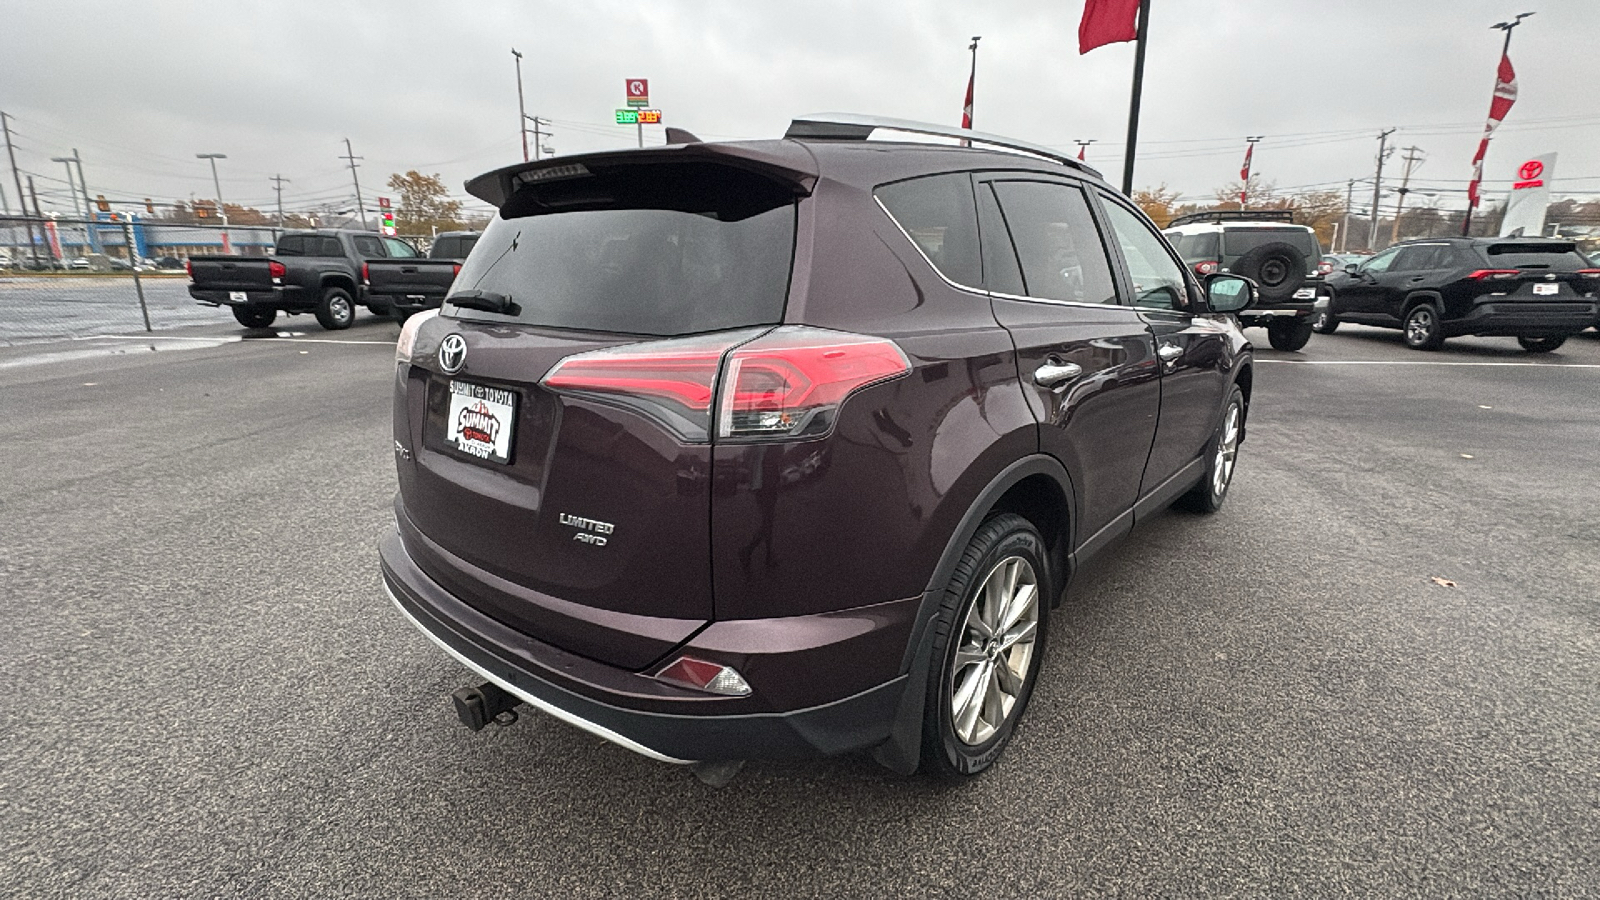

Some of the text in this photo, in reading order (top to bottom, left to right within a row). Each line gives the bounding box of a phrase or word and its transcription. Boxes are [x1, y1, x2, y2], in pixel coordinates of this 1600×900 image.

[450, 380, 513, 407] SUMMIT TOYOTA
[457, 409, 500, 442] SUMMIT
[458, 442, 489, 459] AKRON
[559, 512, 615, 535] LIMITED
[573, 532, 608, 546] AWD
